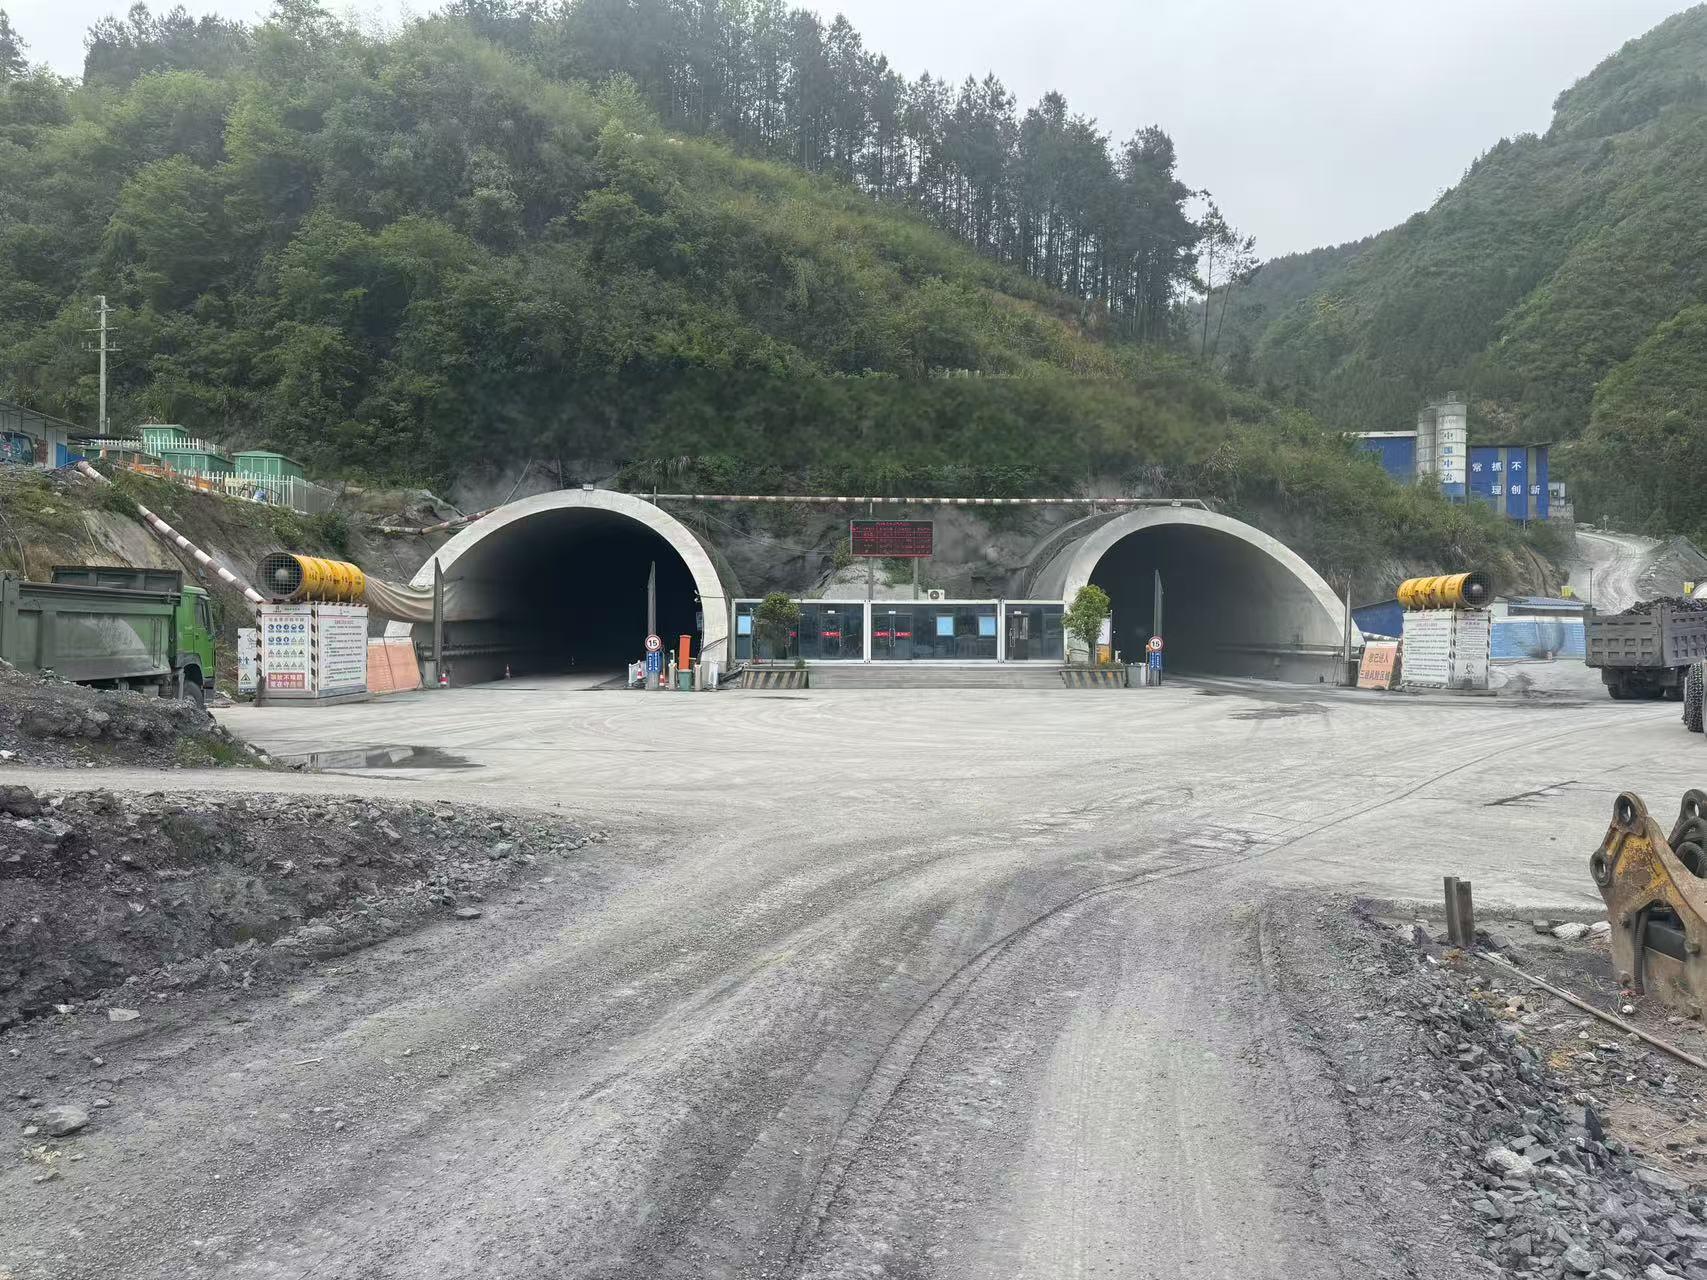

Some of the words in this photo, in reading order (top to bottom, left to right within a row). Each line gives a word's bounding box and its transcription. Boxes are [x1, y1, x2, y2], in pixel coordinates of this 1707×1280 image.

[1442, 431, 1453, 482] 中国中冶
[1472, 461, 1522, 472] 常抓不
[1491, 484, 1541, 495] 理创新
[648, 639, 658, 647] 15
[1360, 669, 1391, 680] 三级风险区域
